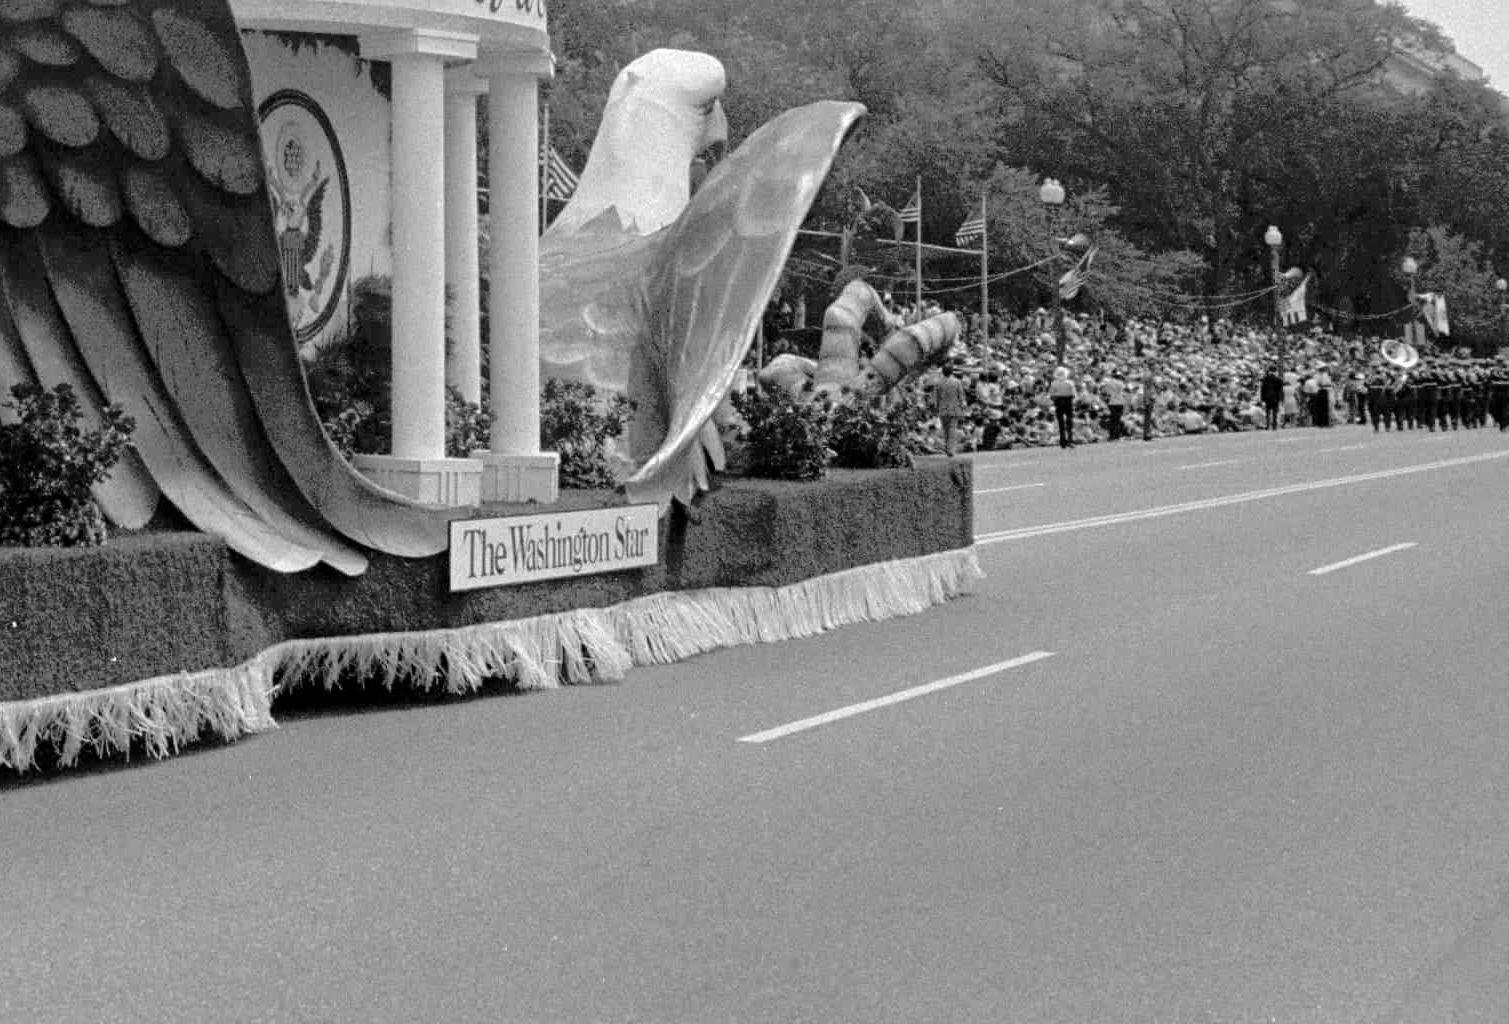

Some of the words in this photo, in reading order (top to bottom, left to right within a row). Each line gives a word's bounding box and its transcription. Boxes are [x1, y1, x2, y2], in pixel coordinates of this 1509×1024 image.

[463, 529, 507, 578] The
[509, 520, 610, 573] Washington
[613, 516, 649, 561] Star
